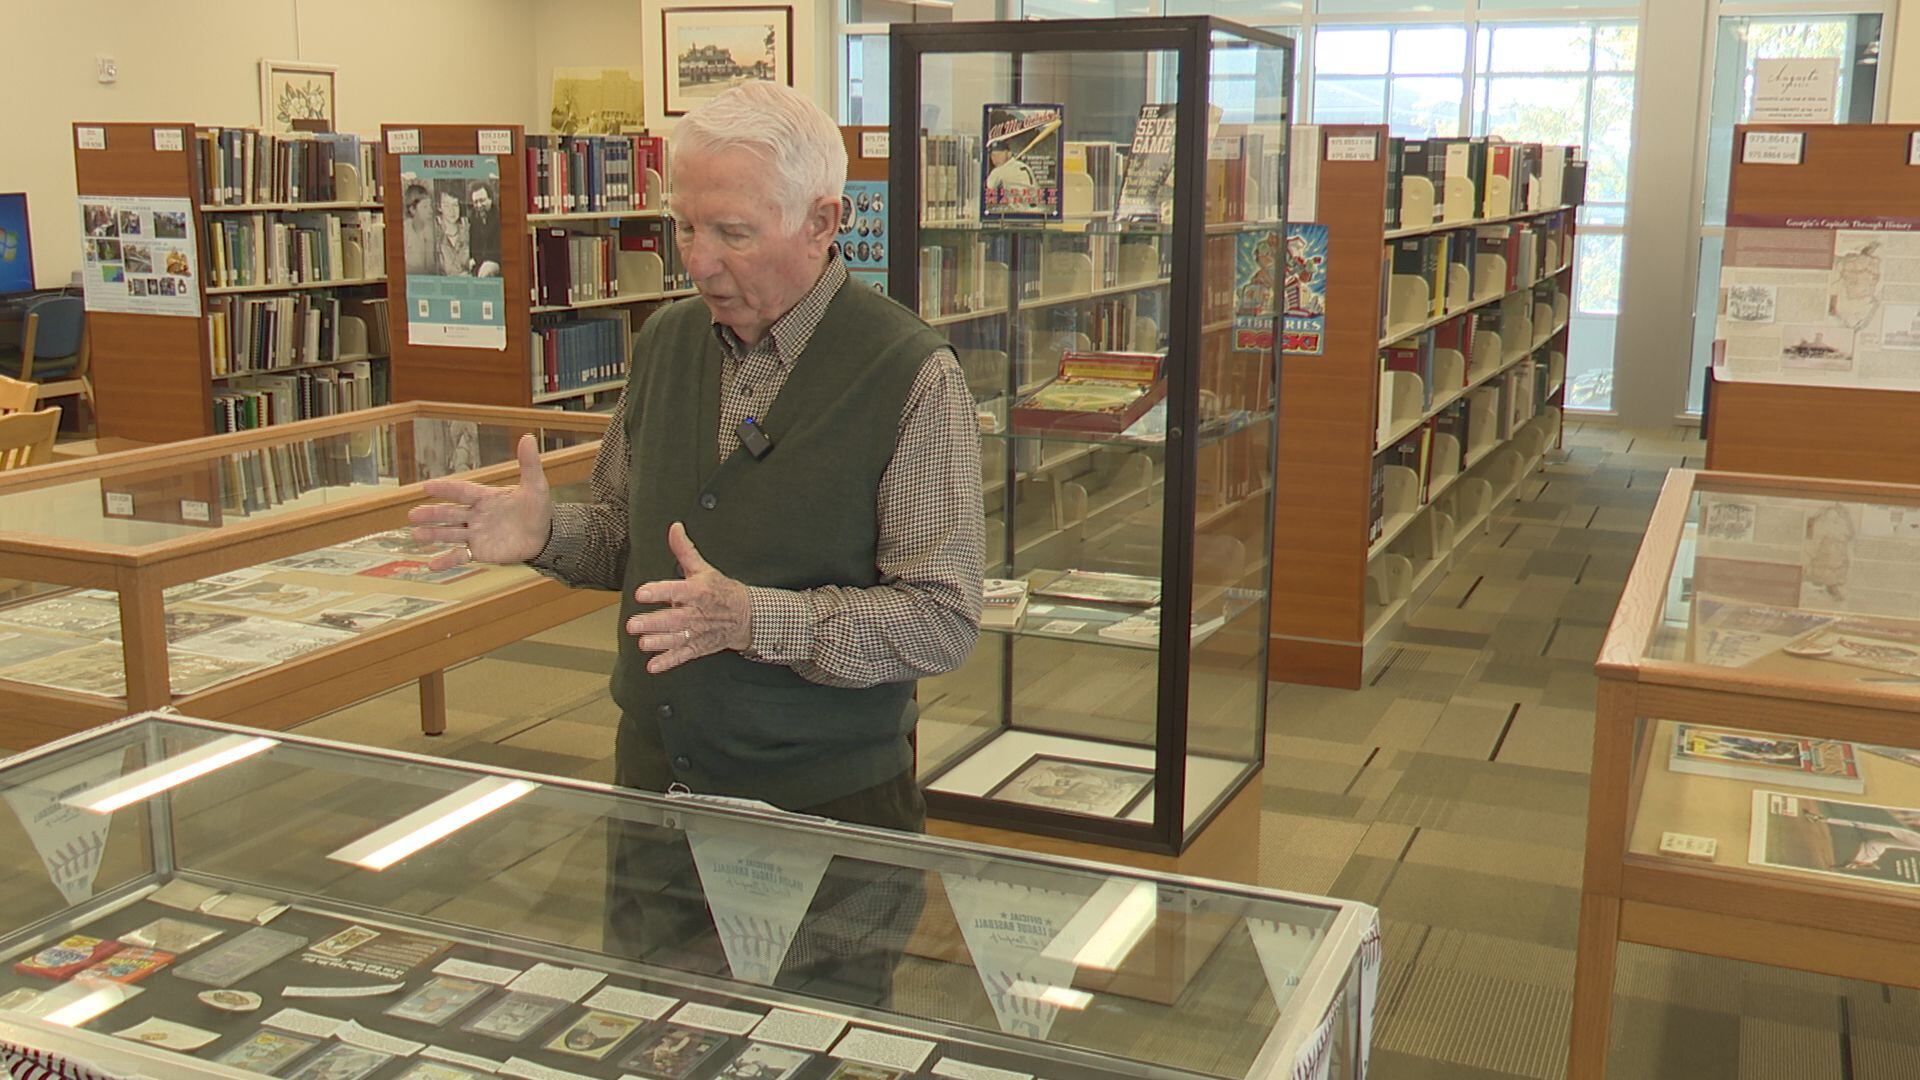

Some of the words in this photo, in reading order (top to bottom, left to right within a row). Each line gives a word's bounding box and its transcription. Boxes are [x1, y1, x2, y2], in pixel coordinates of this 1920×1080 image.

[1142, 106, 1160, 118] THE
[1135, 119, 1176, 136] SEVE
[1131, 136, 1173, 154] GAME
[423, 160, 447, 168] READ
[449, 160, 475, 168] MORE
[1785, 218, 1819, 230] Georgia's
[1820, 219, 1849, 230] Capitals
[1852, 220, 1883, 231] Through
[1884, 221, 1912, 231] History
[1236, 318, 1321, 331] LIBRRIES
